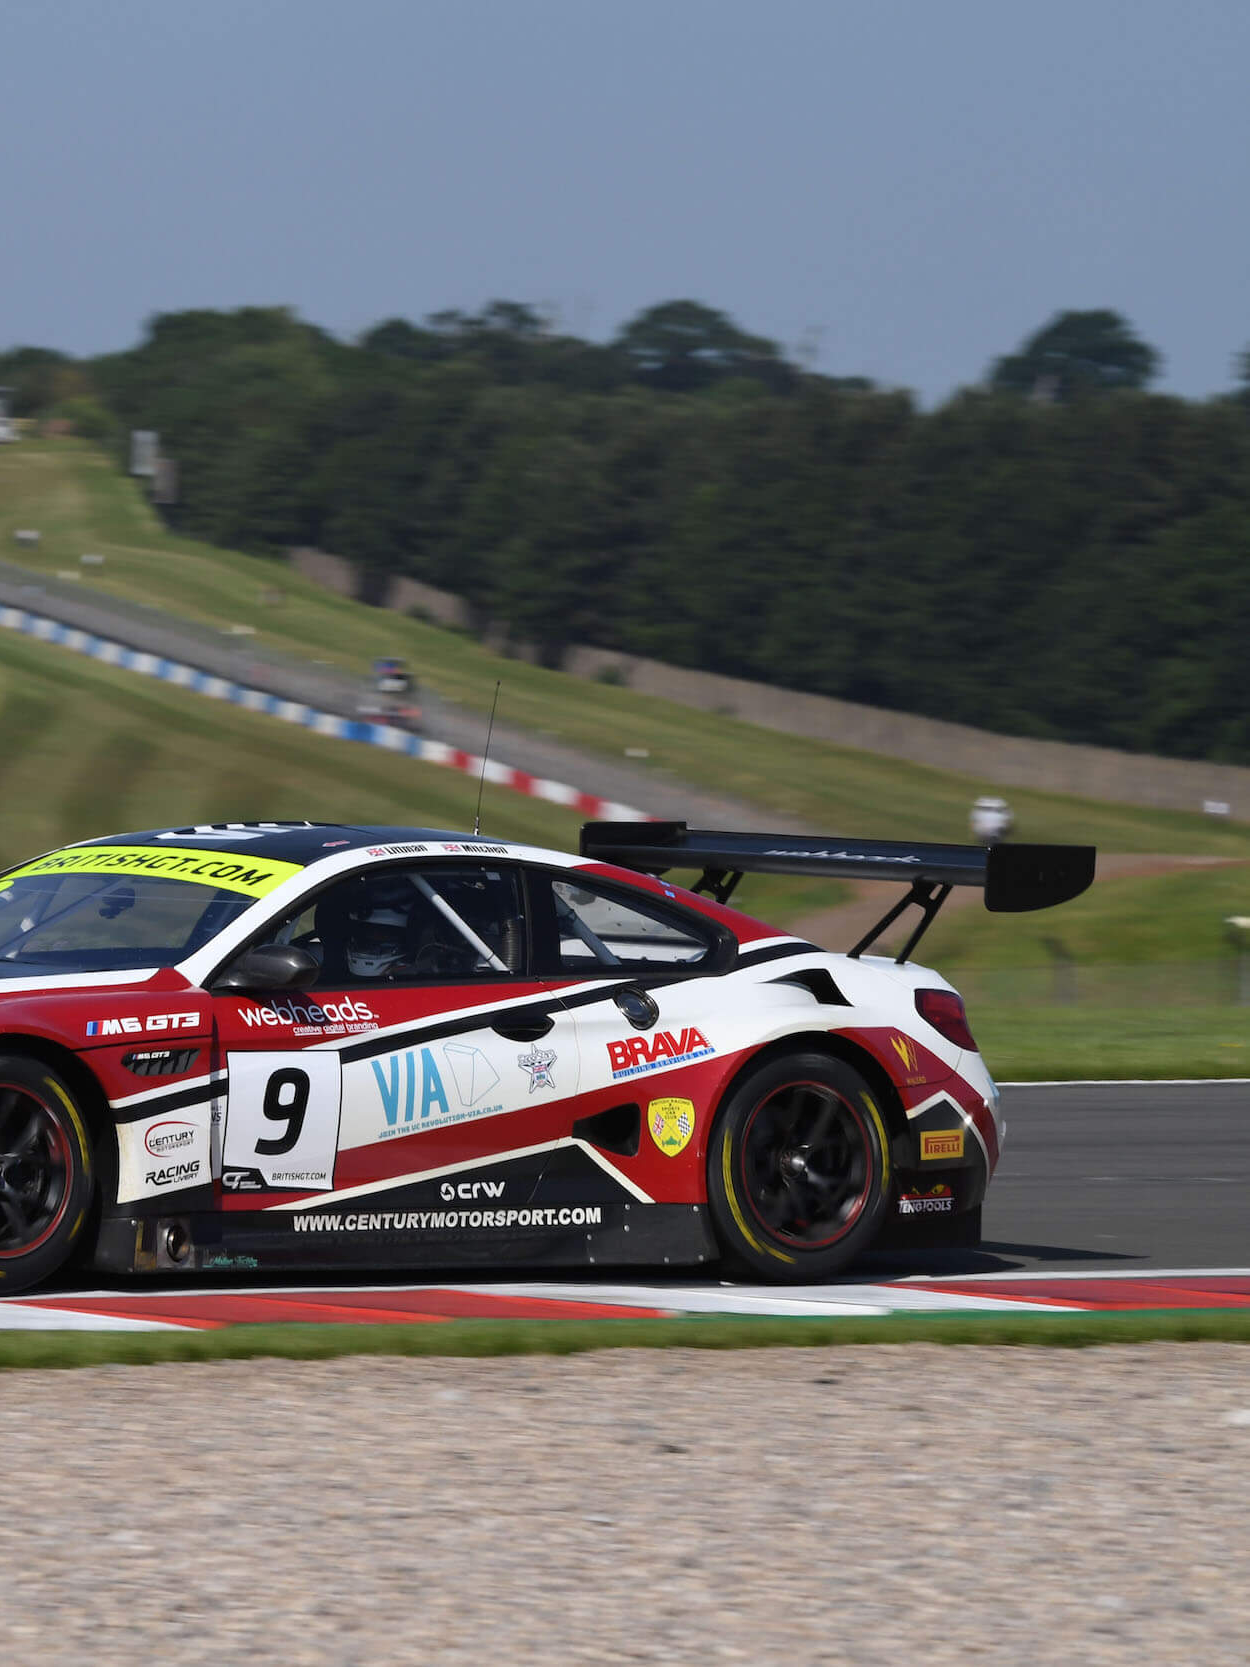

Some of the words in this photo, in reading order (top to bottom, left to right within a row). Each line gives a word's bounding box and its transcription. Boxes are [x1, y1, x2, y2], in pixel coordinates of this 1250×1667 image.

[460, 844, 509, 854] Mitchell
[30, 854, 274, 886] BRITISHGT.COM
[102, 1016, 142, 1035] M6
[146, 1012, 200, 1031] GT3
[237, 995, 374, 1027] webheads
[606, 1027, 710, 1072] BRAVA
[371, 1047, 449, 1127] VIA
[254, 1067, 310, 1155] 9
[149, 1130, 194, 1148] CENTURY
[398, 1125, 410, 1134] THE
[924, 1135, 960, 1154] PIRELLI
[145, 1160, 200, 1186] RACING
[271, 1172, 327, 1181] BRITISHGT.COM
[293, 1207, 602, 1232] WWW.CENTURYMOTORSPORT.COM
